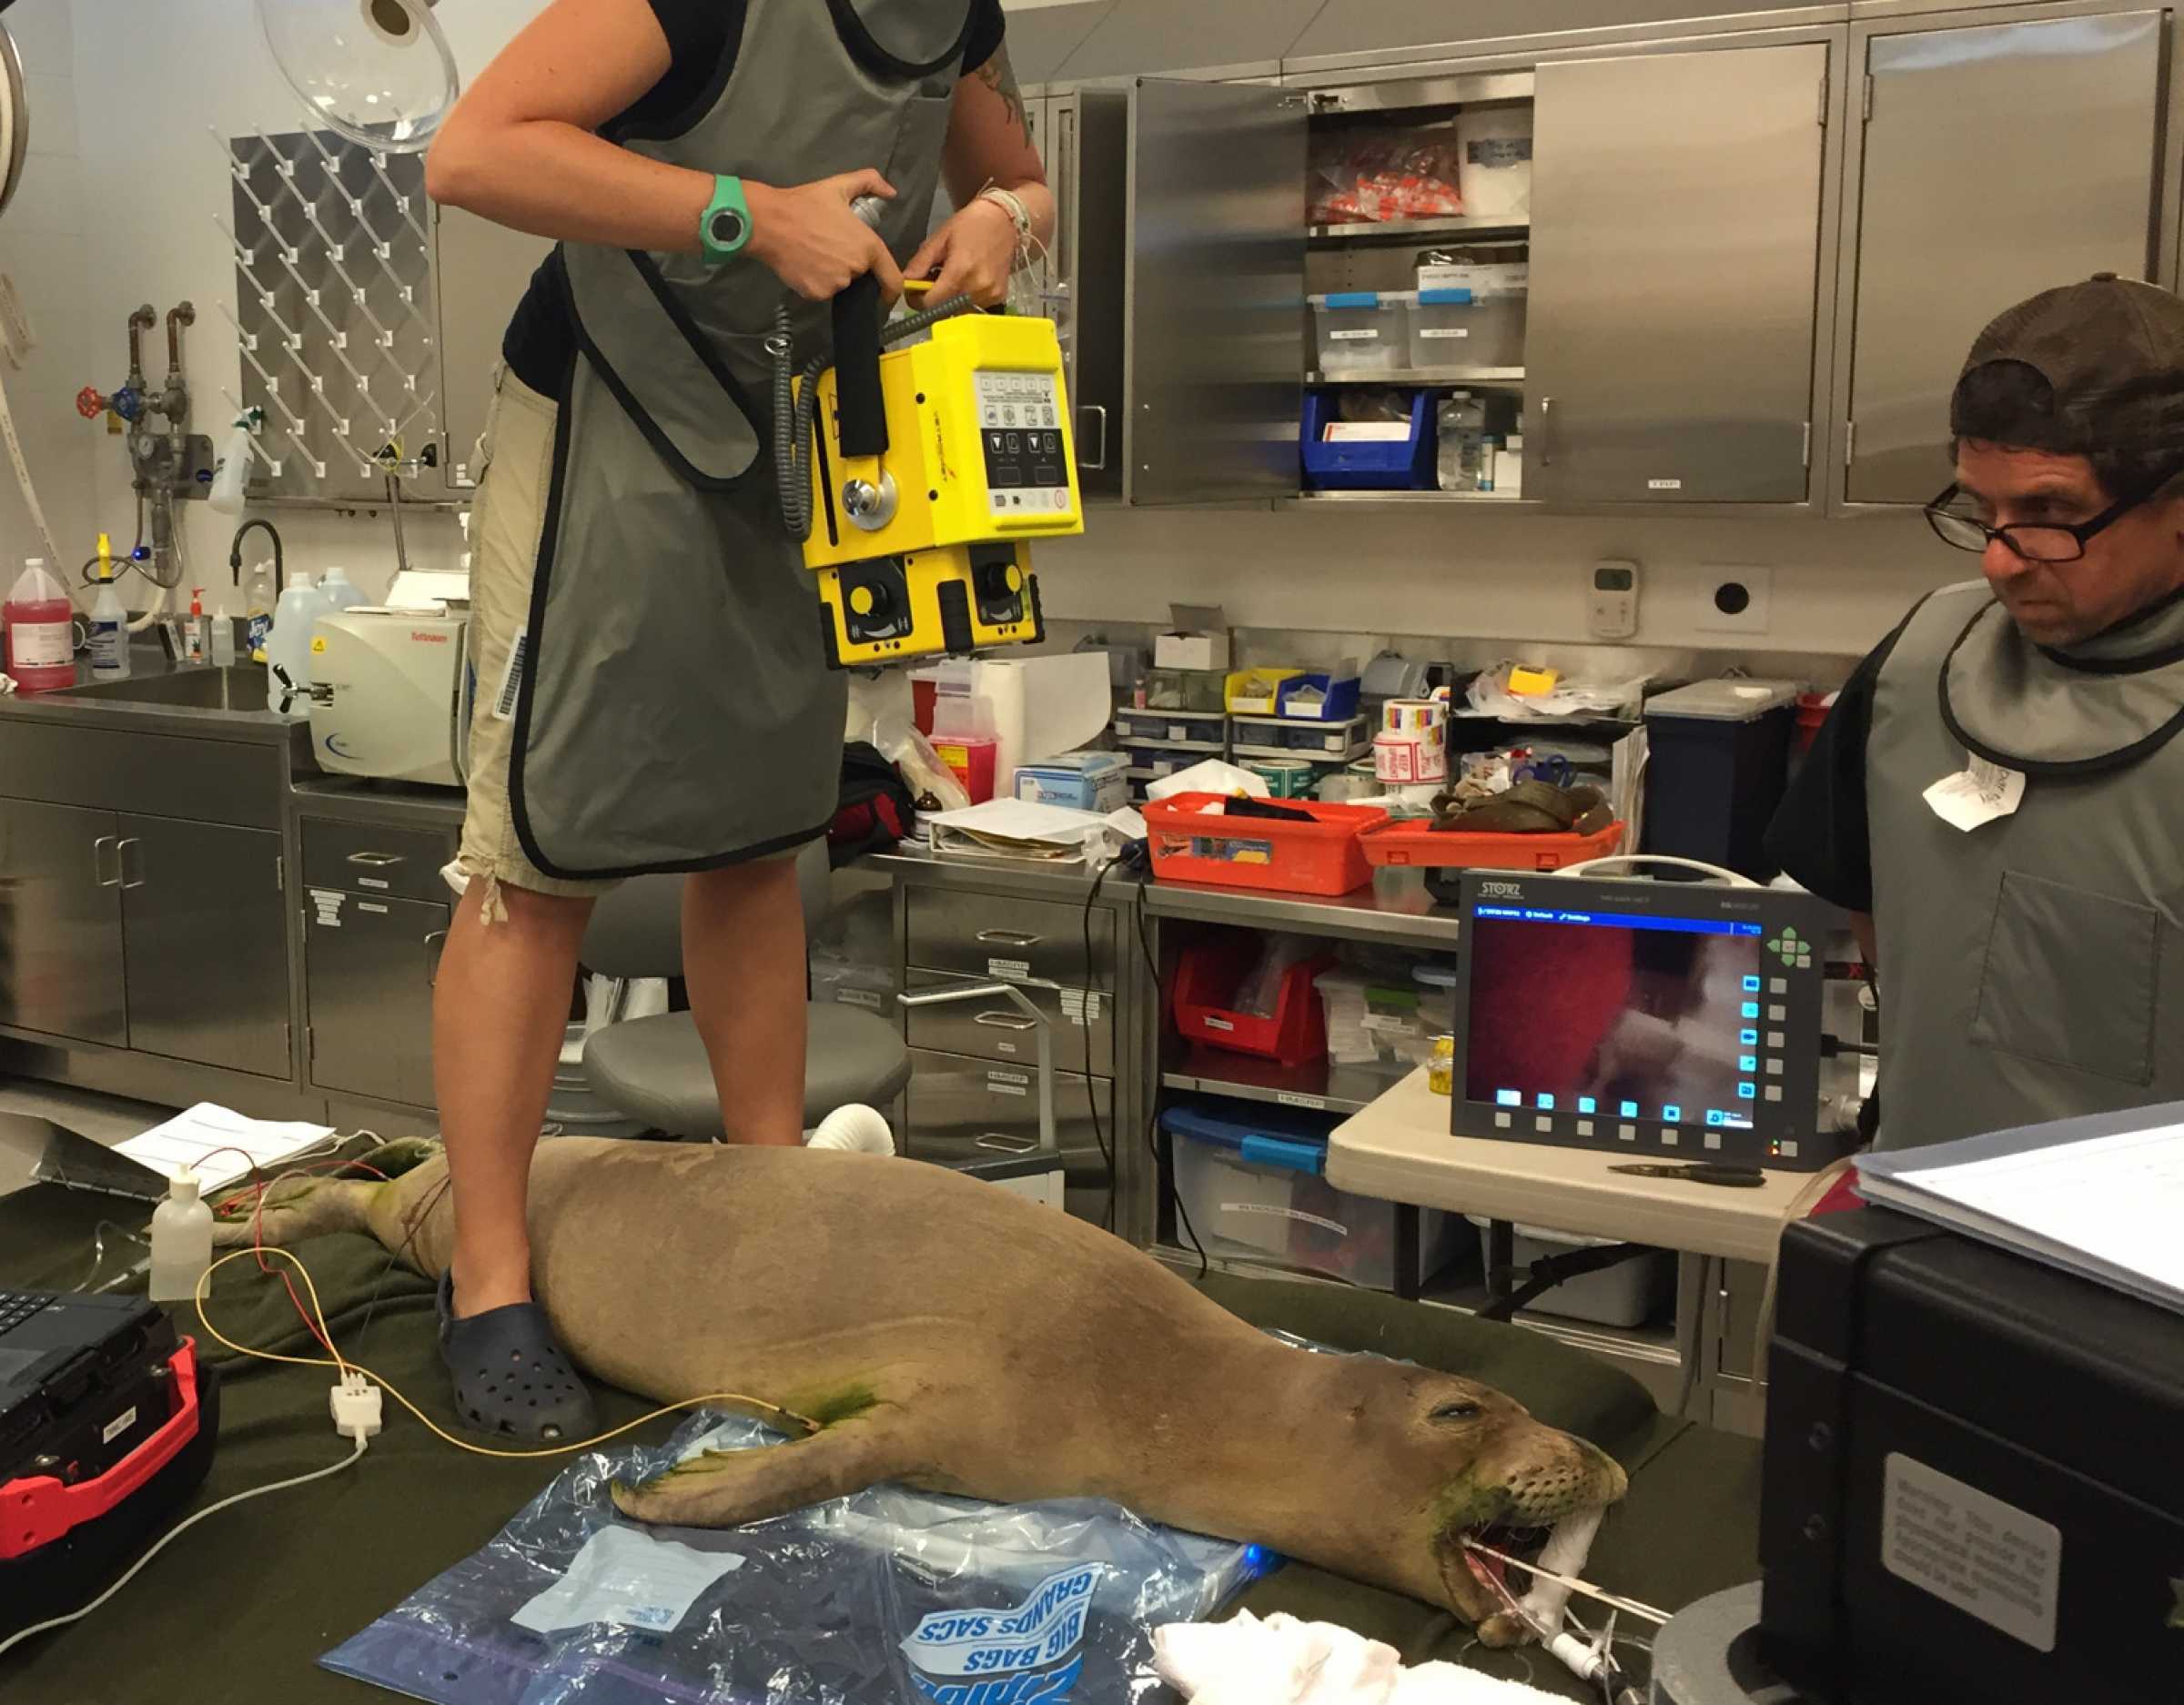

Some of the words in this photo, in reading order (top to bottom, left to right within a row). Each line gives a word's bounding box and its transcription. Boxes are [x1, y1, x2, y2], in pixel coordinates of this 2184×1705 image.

[1481, 883, 1522, 895] STORZ
[997, 1571, 1093, 1634] GRANDS
[917, 1616, 995, 1641] SACS
[1045, 1609, 1083, 1659] BIG
[964, 1643, 1041, 1672] BAGS
